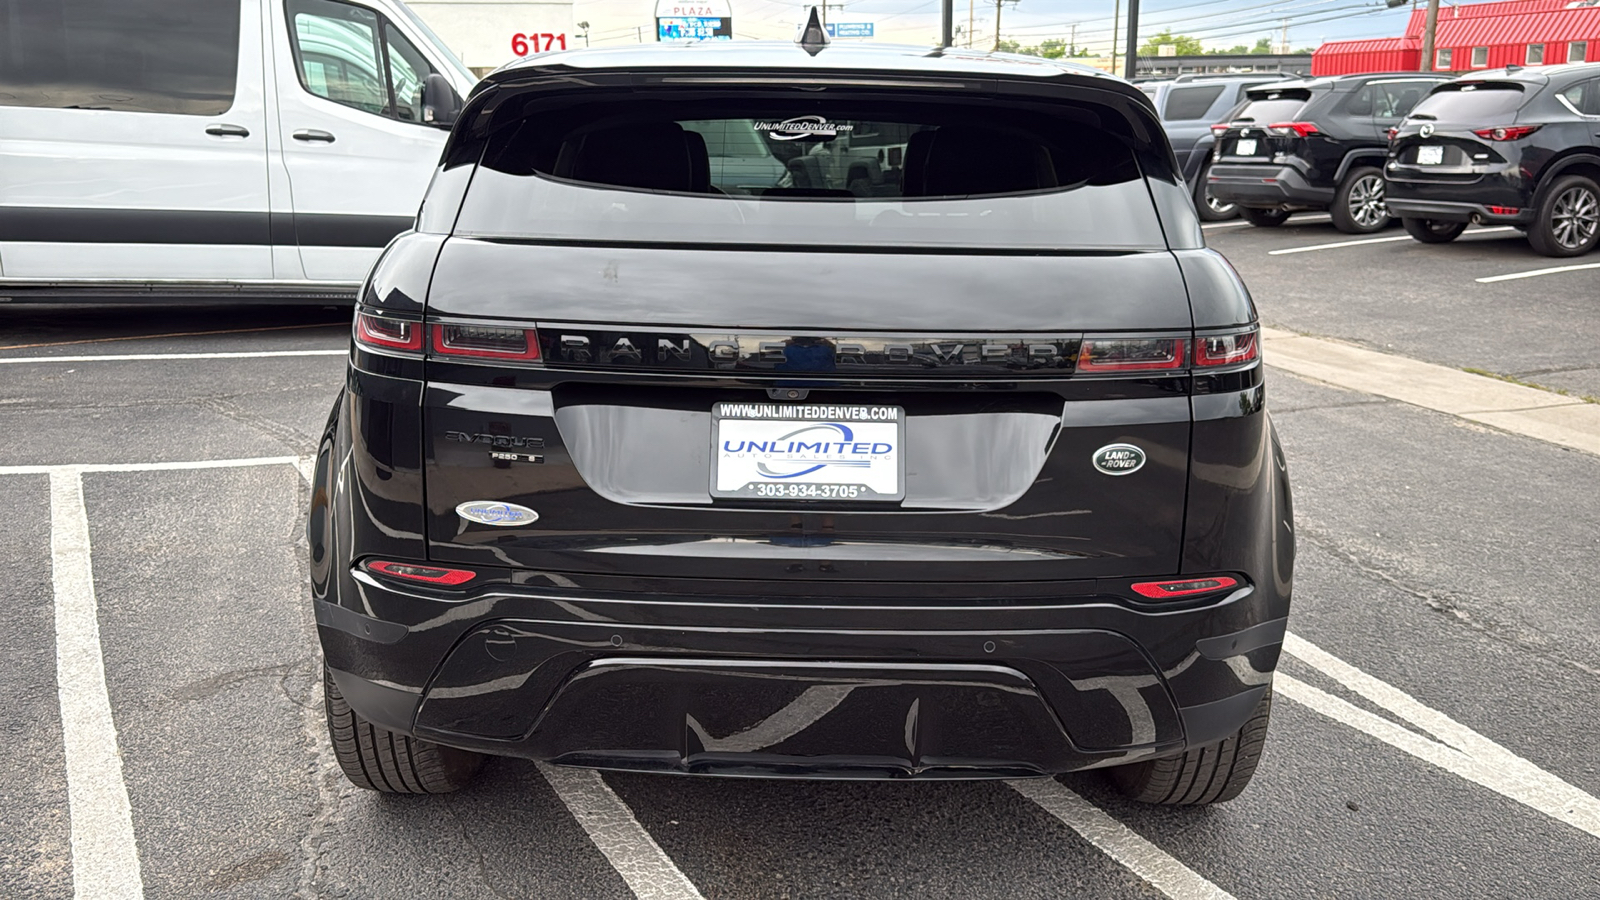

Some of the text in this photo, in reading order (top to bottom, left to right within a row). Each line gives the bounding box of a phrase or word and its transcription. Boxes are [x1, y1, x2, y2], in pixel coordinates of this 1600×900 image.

[673, 7, 713, 16] PLAZA
[511, 32, 567, 58] 6171
[560, 334, 1059, 366] RANGE ROVER
[720, 403, 898, 420] WWWUNLIMITEDDENVER.COM
[445, 430, 545, 449] EVOQUE
[723, 440, 893, 455] UNLIMITED
[491, 452, 518, 461] P250
[1104, 451, 1130, 460] LAND
[1106, 459, 1137, 468] ROVER
[757, 483, 858, 498] 303-934-3705
